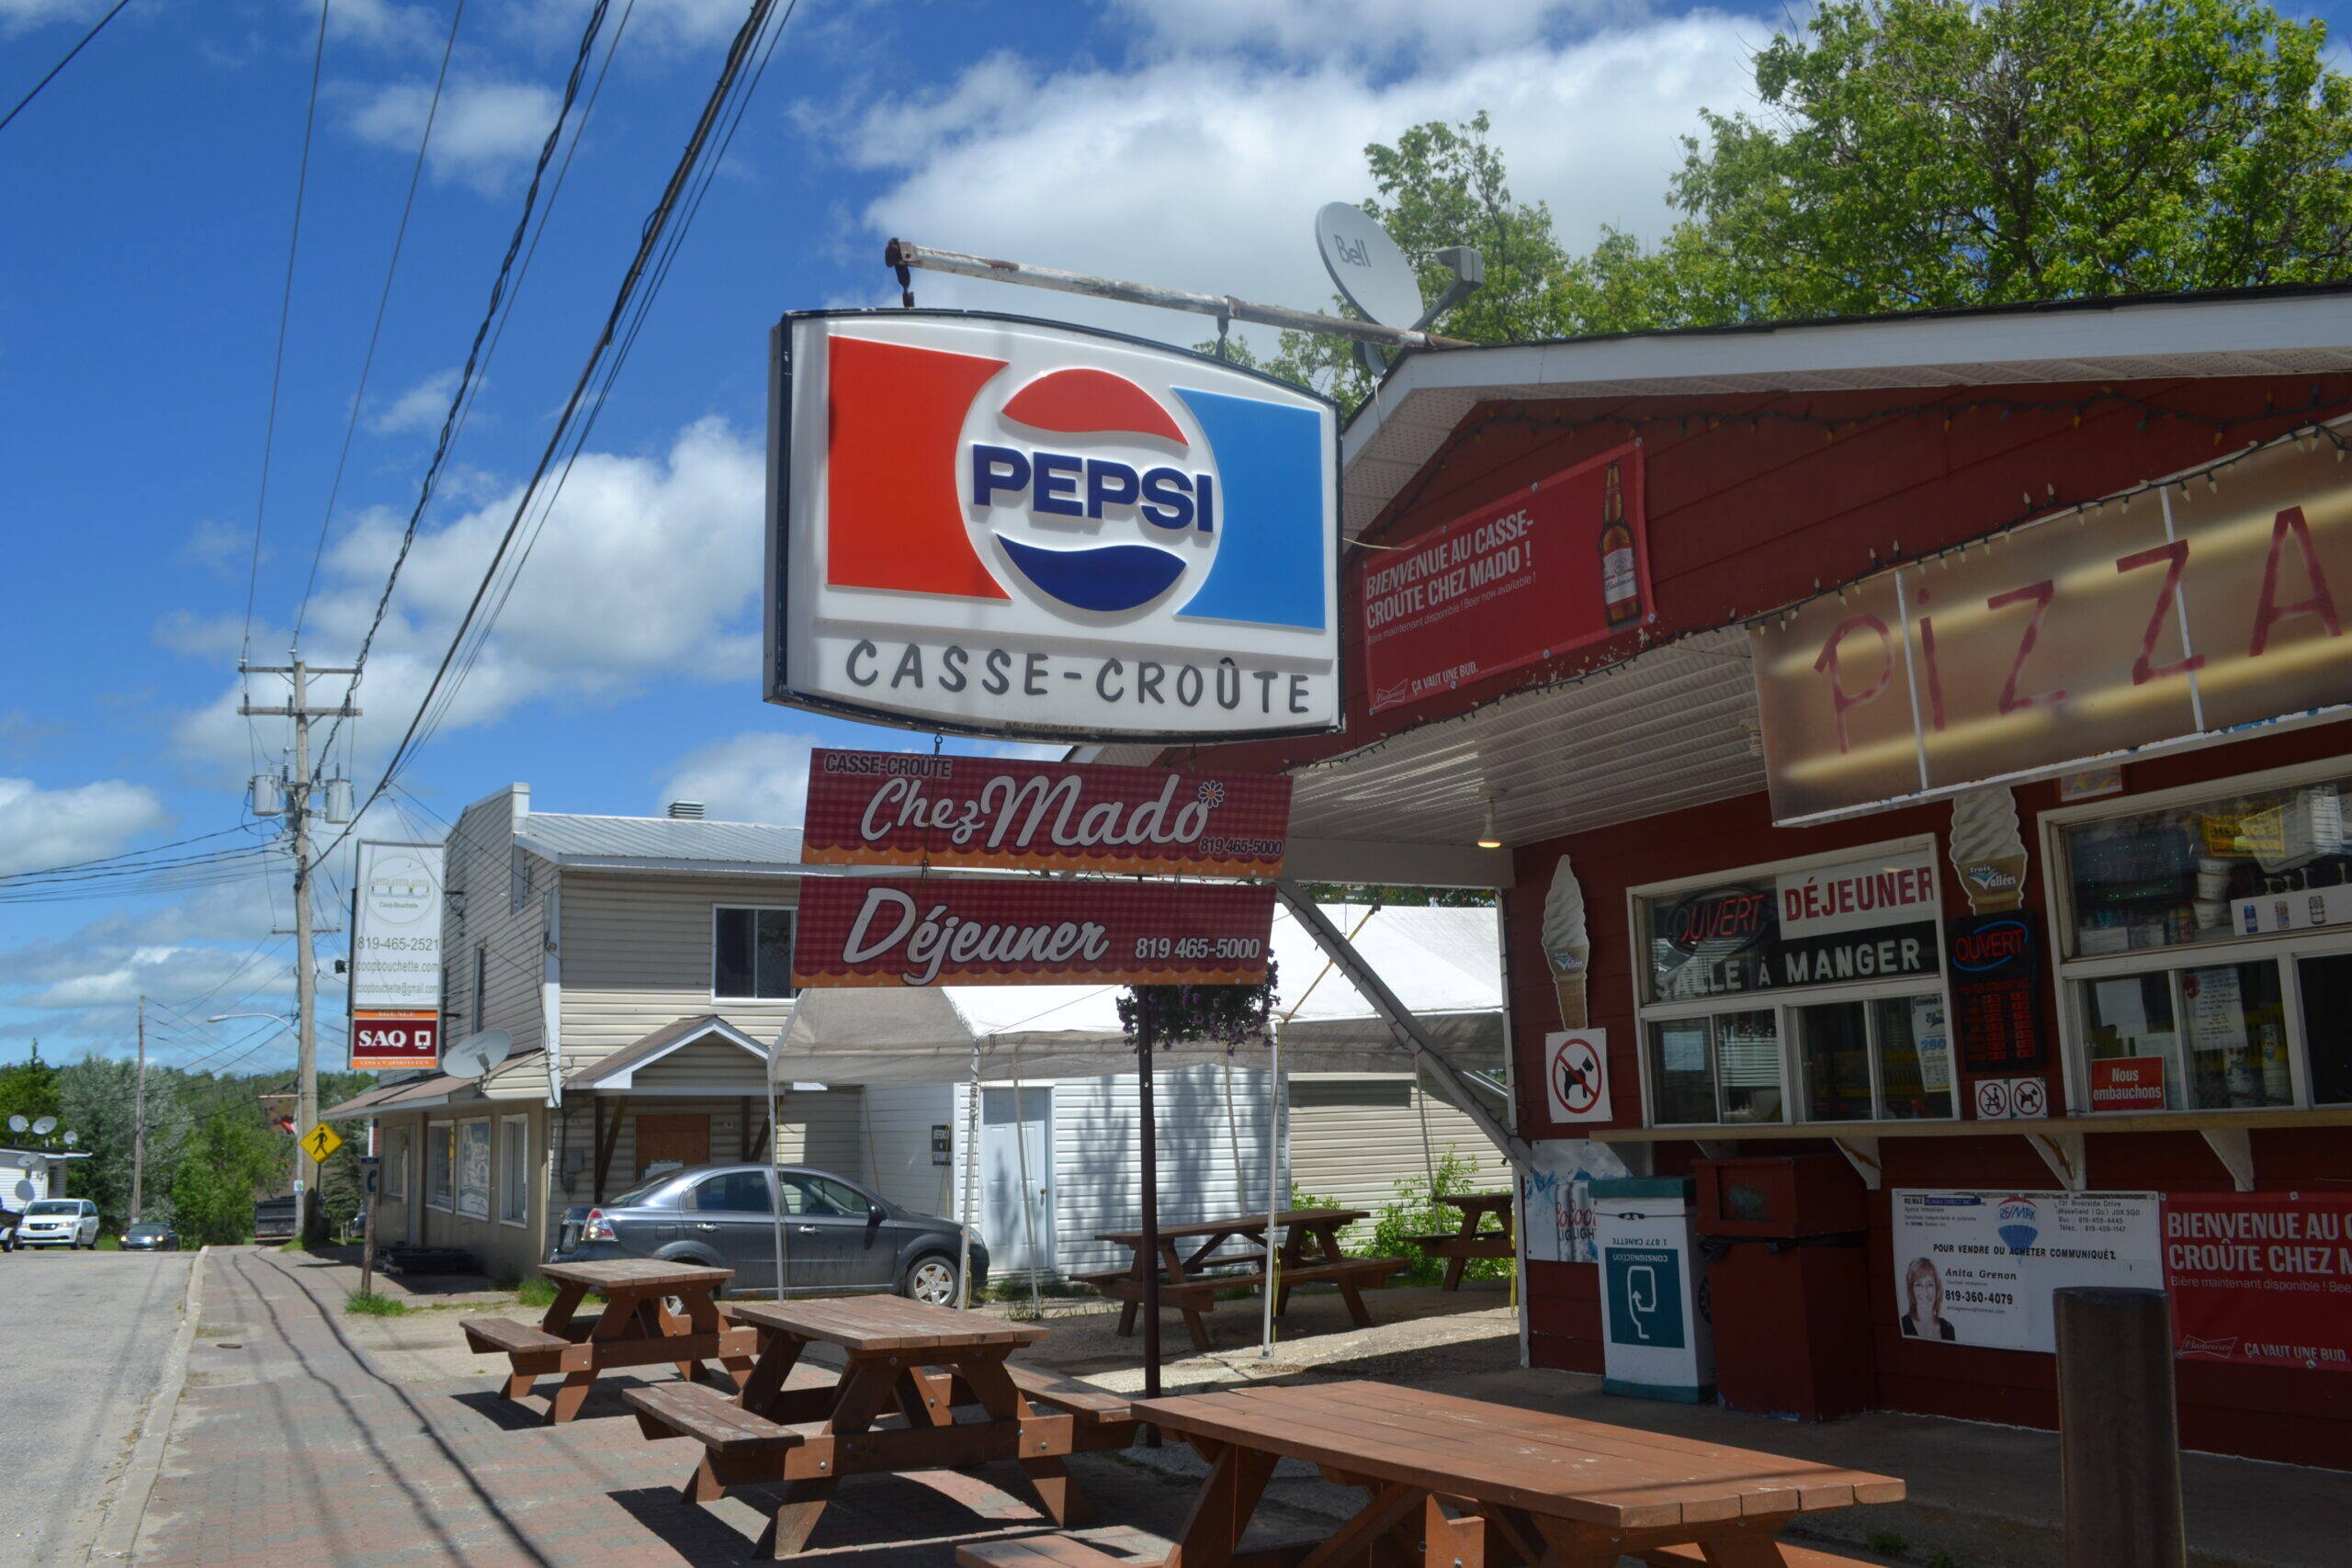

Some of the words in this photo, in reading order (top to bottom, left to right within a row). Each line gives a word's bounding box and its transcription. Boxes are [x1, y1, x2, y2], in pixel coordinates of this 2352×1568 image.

[1333, 234, 1372, 267] Bell
[973, 444, 1214, 533] PEPSI
[1366, 544, 1449, 600] BIENVENUE
[1452, 534, 1471, 565] AU
[1475, 509, 1534, 554] CASSE-
[1367, 586, 1425, 629] CROÛTE
[1428, 568, 1467, 606] CHEZ
[1470, 546, 1521, 590] MADO
[1383, 617, 1423, 639] maintenant
[1424, 603, 1459, 628] disponible
[1481, 589, 1496, 601] now
[1498, 577, 1532, 596] available
[846, 640, 1309, 714] CASSE-CROÛTE
[1411, 681, 1422, 695] ÇA
[1423, 673, 1442, 689] VAUT
[1443, 667, 1459, 682] UNE
[1459, 661, 1479, 677] BUD.
[824, 752, 953, 779] CASSE-CROÛTE
[859, 776, 987, 846] Chez
[979, 773, 1211, 848] Mado
[1200, 838, 1224, 853] 819
[1226, 840, 1283, 856] 465-5000
[1784, 868, 1935, 921] DÉJEUNER
[1673, 894, 1765, 942] OUVERT
[356, 935, 438, 952] 819-465-2521
[842, 886, 1110, 987] Déjeuner
[1135, 938, 1170, 959] 819
[1173, 938, 1261, 960] 465-5000
[1954, 929, 2024, 963] OUVERT
[356, 959, 439, 975] coopbouchette.com
[1785, 938, 1922, 984] MANGER
[358, 1030, 407, 1047] SAQ
[2111, 1068, 2139, 1082] Nous
[2093, 1086, 2162, 1100] embauchons
[1999, 1203, 2037, 1221] RE/MAX
[1572, 1227, 1596, 1240] LIGH
[2168, 1212, 2301, 1239] BIENVENUE
[2306, 1213, 2339, 1240] AU
[1933, 1244, 1954, 1253] POUR
[1958, 1245, 1989, 1255] VENDRE
[1994, 1246, 2006, 1255] OU
[2009, 1247, 2046, 1257] ACHETER
[2169, 1238, 2264, 1272] CROÛTE
[2267, 1245, 2334, 1274] CHEZ
[1945, 1269, 1973, 1278] Anita
[1979, 1270, 2017, 1280] Grenon
[2171, 1275, 2199, 1286] Bière
[2201, 1278, 2261, 1290] maintenant
[2264, 1279, 2320, 1293] disponible
[1945, 1290, 2013, 1304] 819-360-4079
[2245, 1343, 2260, 1359] ÇA
[2261, 1344, 2290, 1356] VAUT
[2293, 1346, 2317, 1359] UNE
[2321, 1348, 2350, 1361] BUD.
